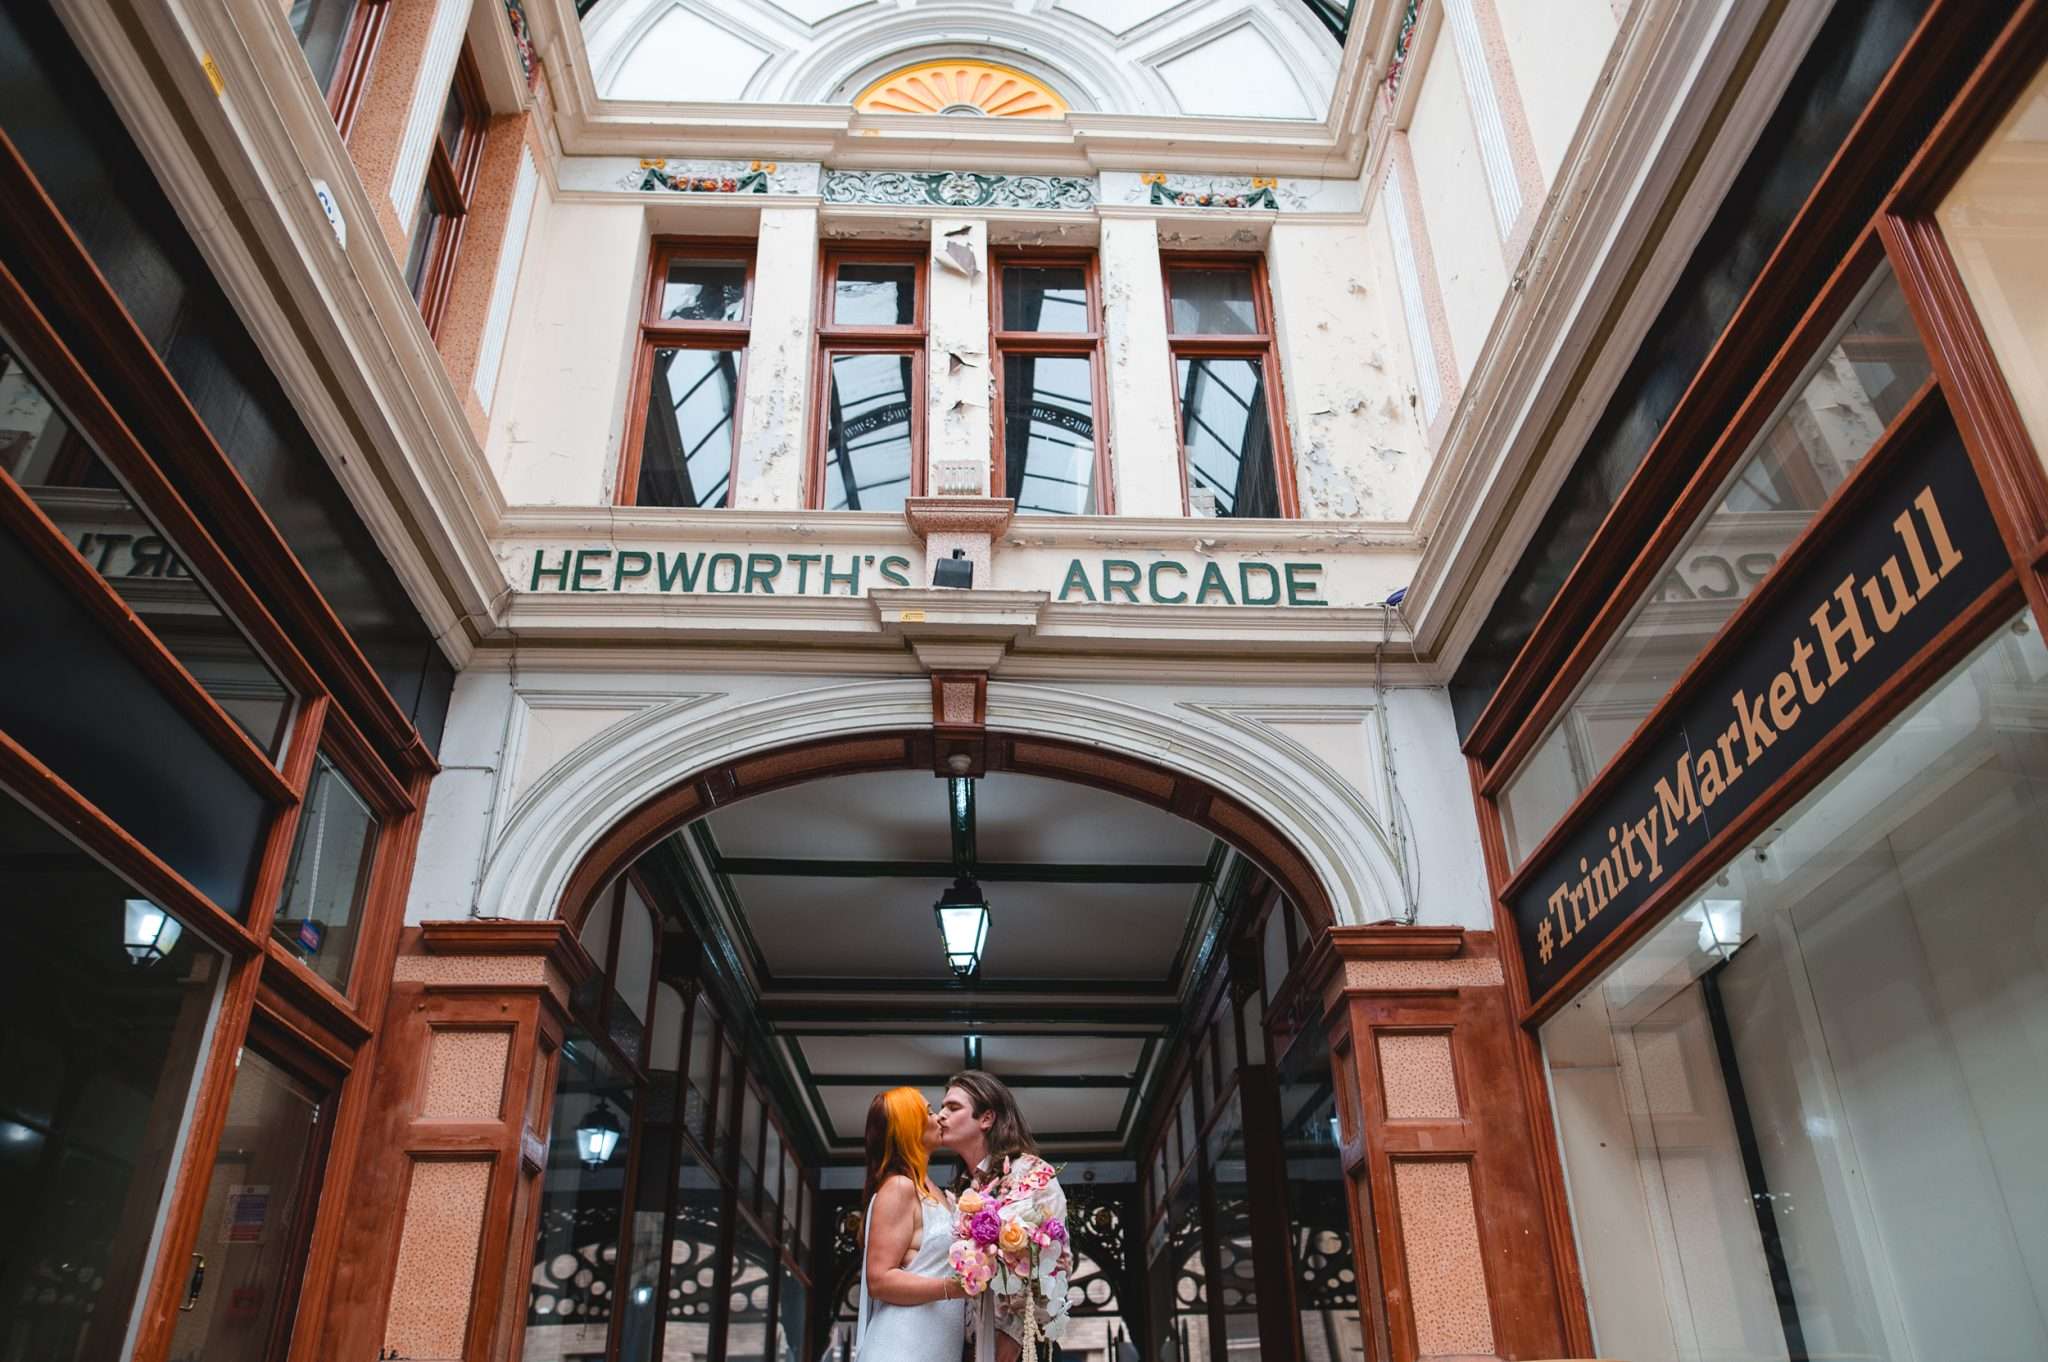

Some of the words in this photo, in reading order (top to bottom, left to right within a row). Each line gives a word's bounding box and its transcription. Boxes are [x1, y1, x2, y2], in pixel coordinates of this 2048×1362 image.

[530, 549, 911, 595] HEPWORTH'S
[1058, 558, 1329, 606] ARCADE
[1536, 484, 1964, 966] #TrinityMarketHull
